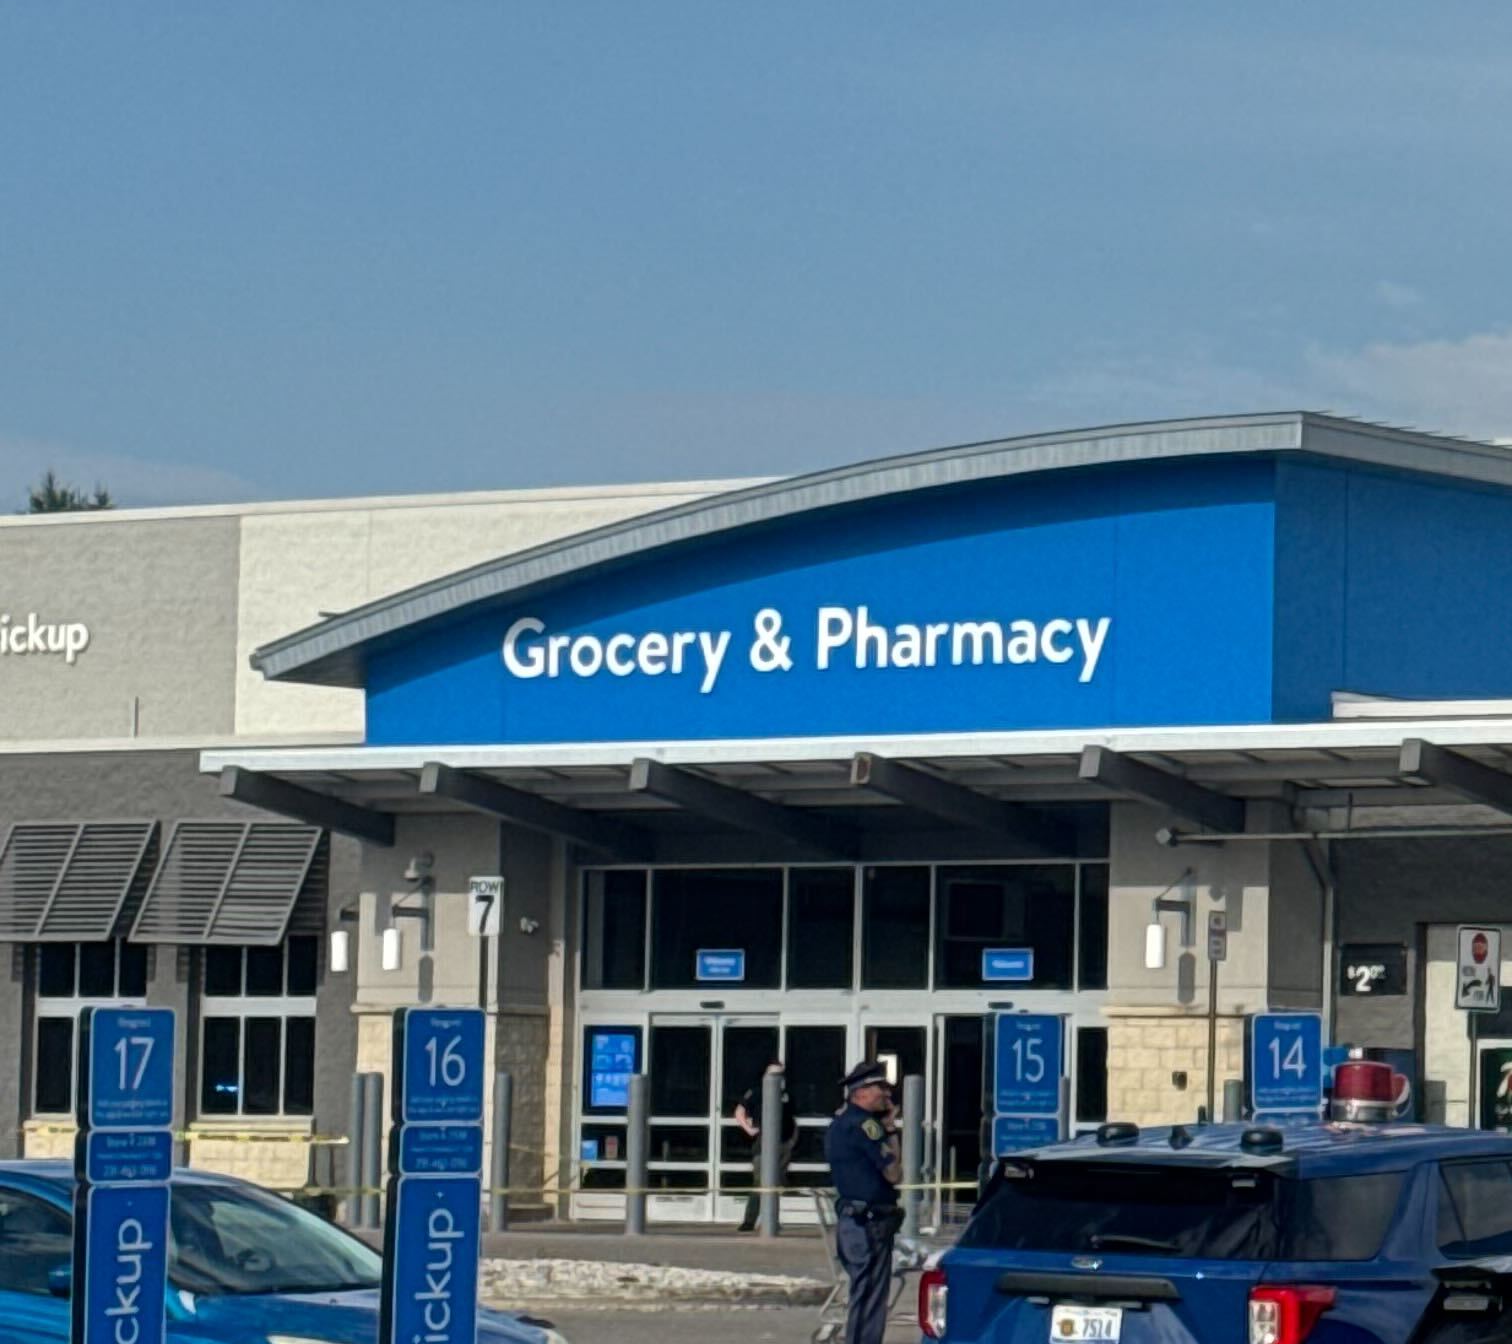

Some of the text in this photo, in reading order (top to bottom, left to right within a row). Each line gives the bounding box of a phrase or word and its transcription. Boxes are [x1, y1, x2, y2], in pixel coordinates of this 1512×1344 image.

[0, 612, 89, 663] ickup
[502, 605, 1112, 694] Grocery & Pharmacy
[471, 880, 500, 893] ROW
[474, 894, 495, 934] 7
[113, 1036, 156, 1091] 17
[424, 1034, 466, 1088] 16
[1012, 1037, 1045, 1083] 15
[1268, 1035, 1307, 1080] 14
